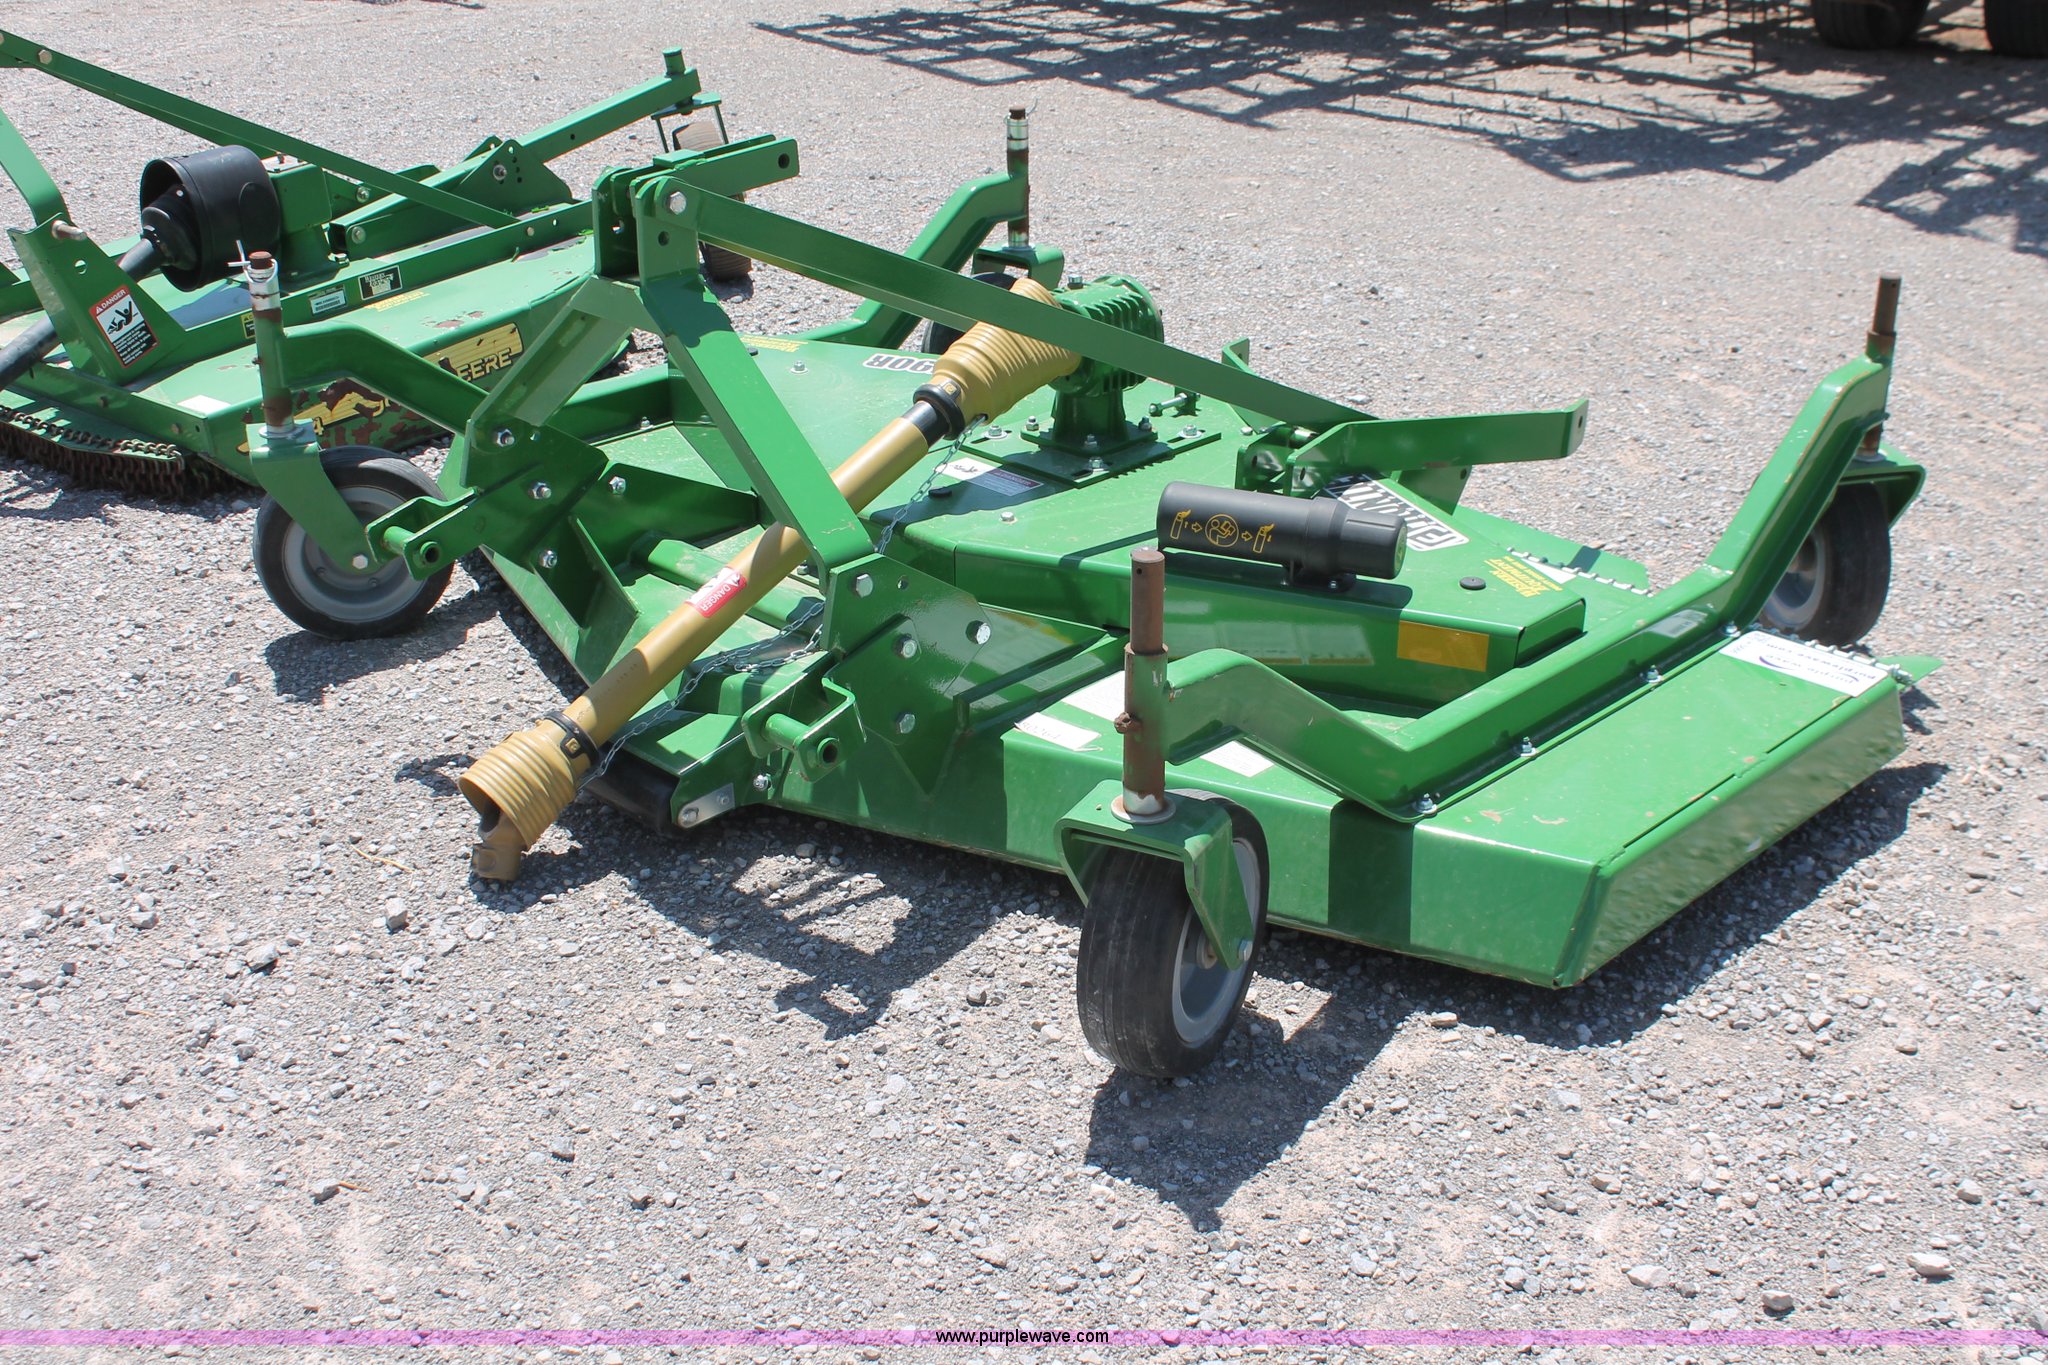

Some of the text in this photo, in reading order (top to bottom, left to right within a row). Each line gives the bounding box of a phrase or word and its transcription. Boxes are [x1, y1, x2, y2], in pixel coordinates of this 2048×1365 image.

[101, 289, 126, 309] DANGER
[455, 347, 513, 381] EERE
[699, 584, 731, 611] DANGER
